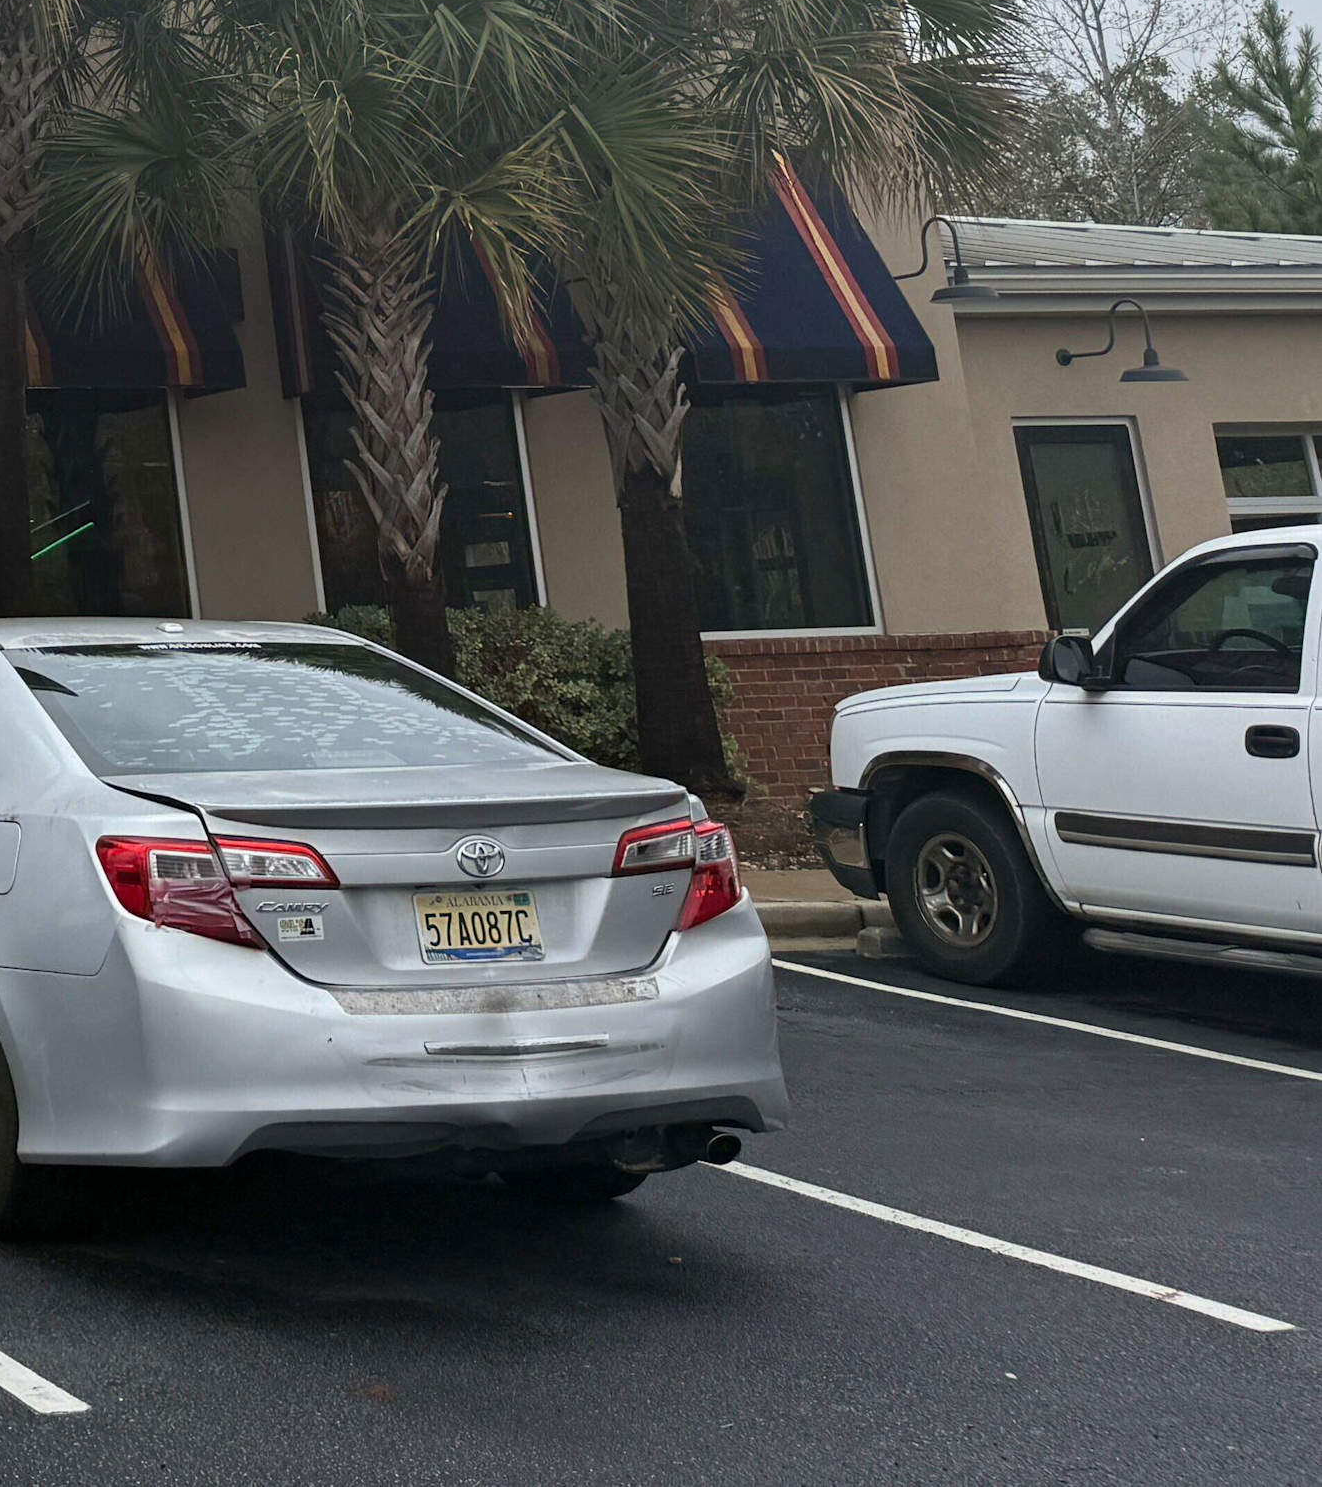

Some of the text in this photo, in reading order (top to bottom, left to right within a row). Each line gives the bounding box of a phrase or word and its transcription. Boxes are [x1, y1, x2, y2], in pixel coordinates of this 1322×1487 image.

[256, 901, 330, 914] CAMRY
[446, 896, 504, 908] ALABAMA
[424, 910, 533, 946] 57A087C
